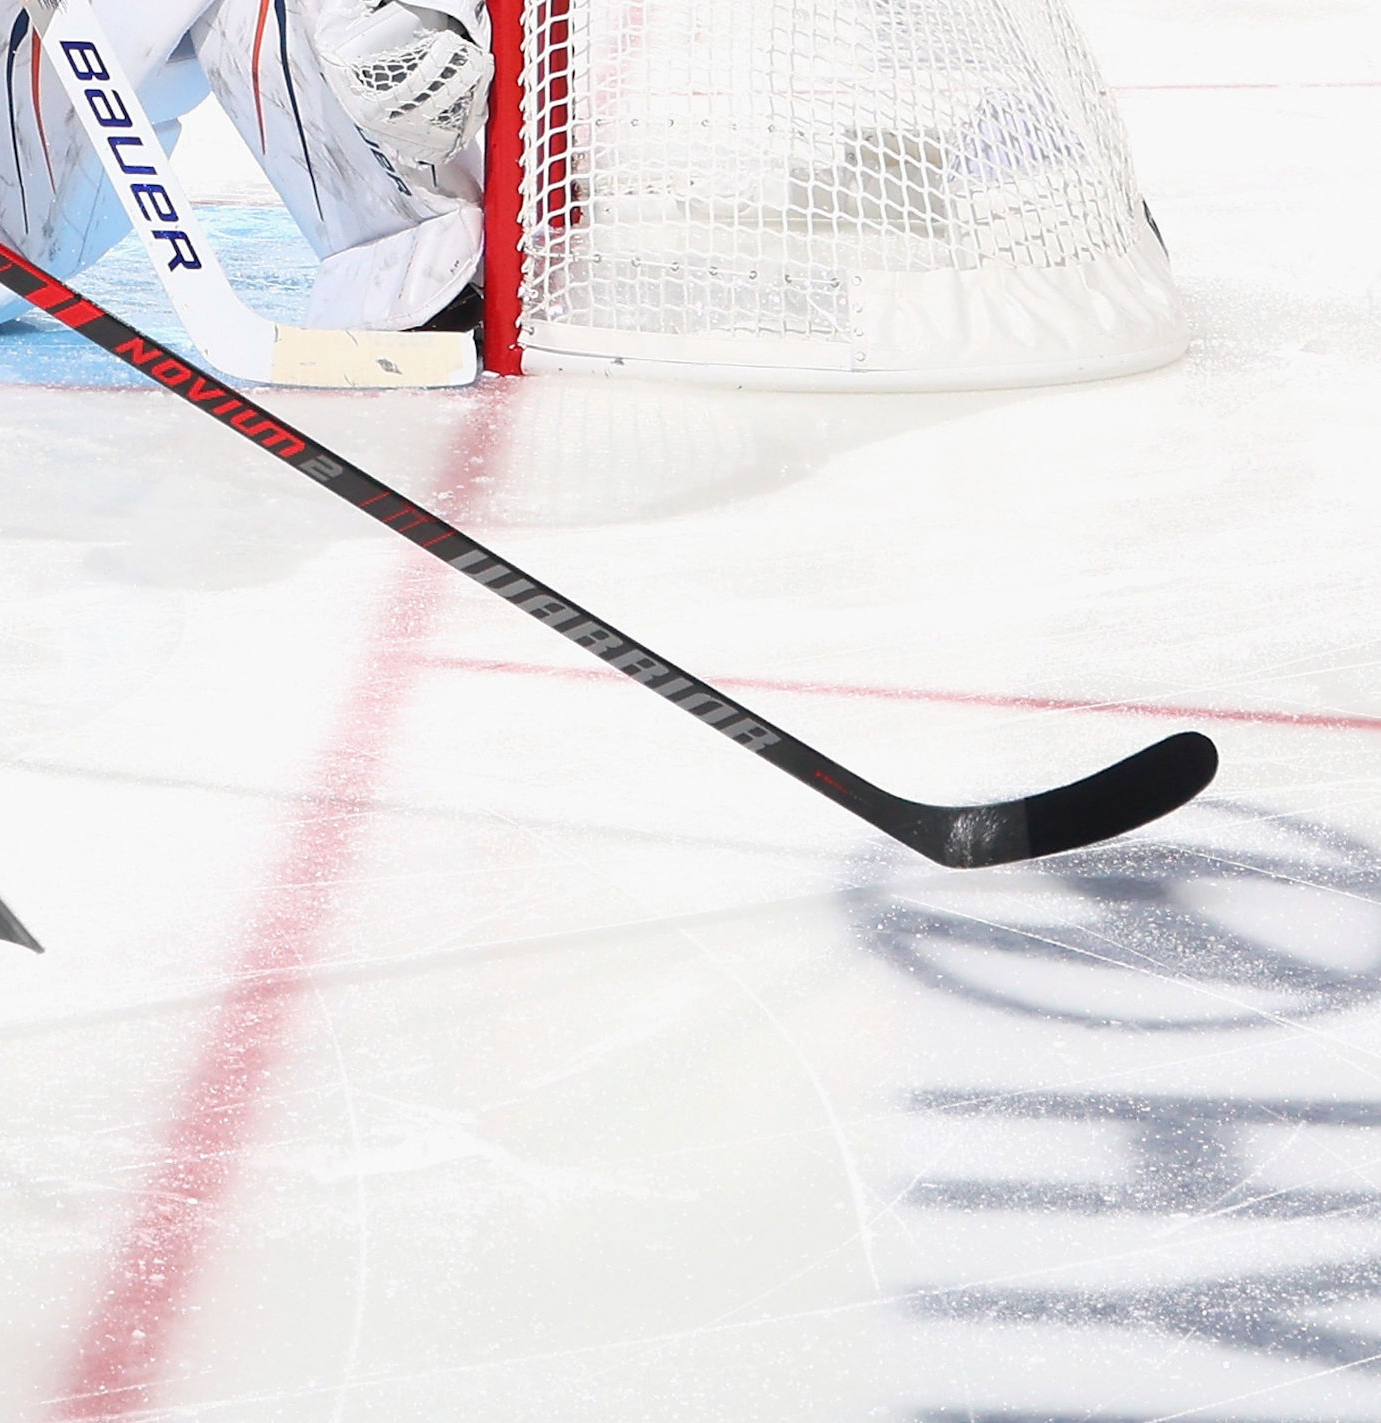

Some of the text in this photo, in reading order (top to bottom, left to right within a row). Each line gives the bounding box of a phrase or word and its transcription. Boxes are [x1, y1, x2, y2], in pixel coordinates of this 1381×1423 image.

[59, 39, 203, 273] BAUER
[113, 334, 343, 482] NOVIUM 2
[445, 548, 784, 756] WARRIOR
